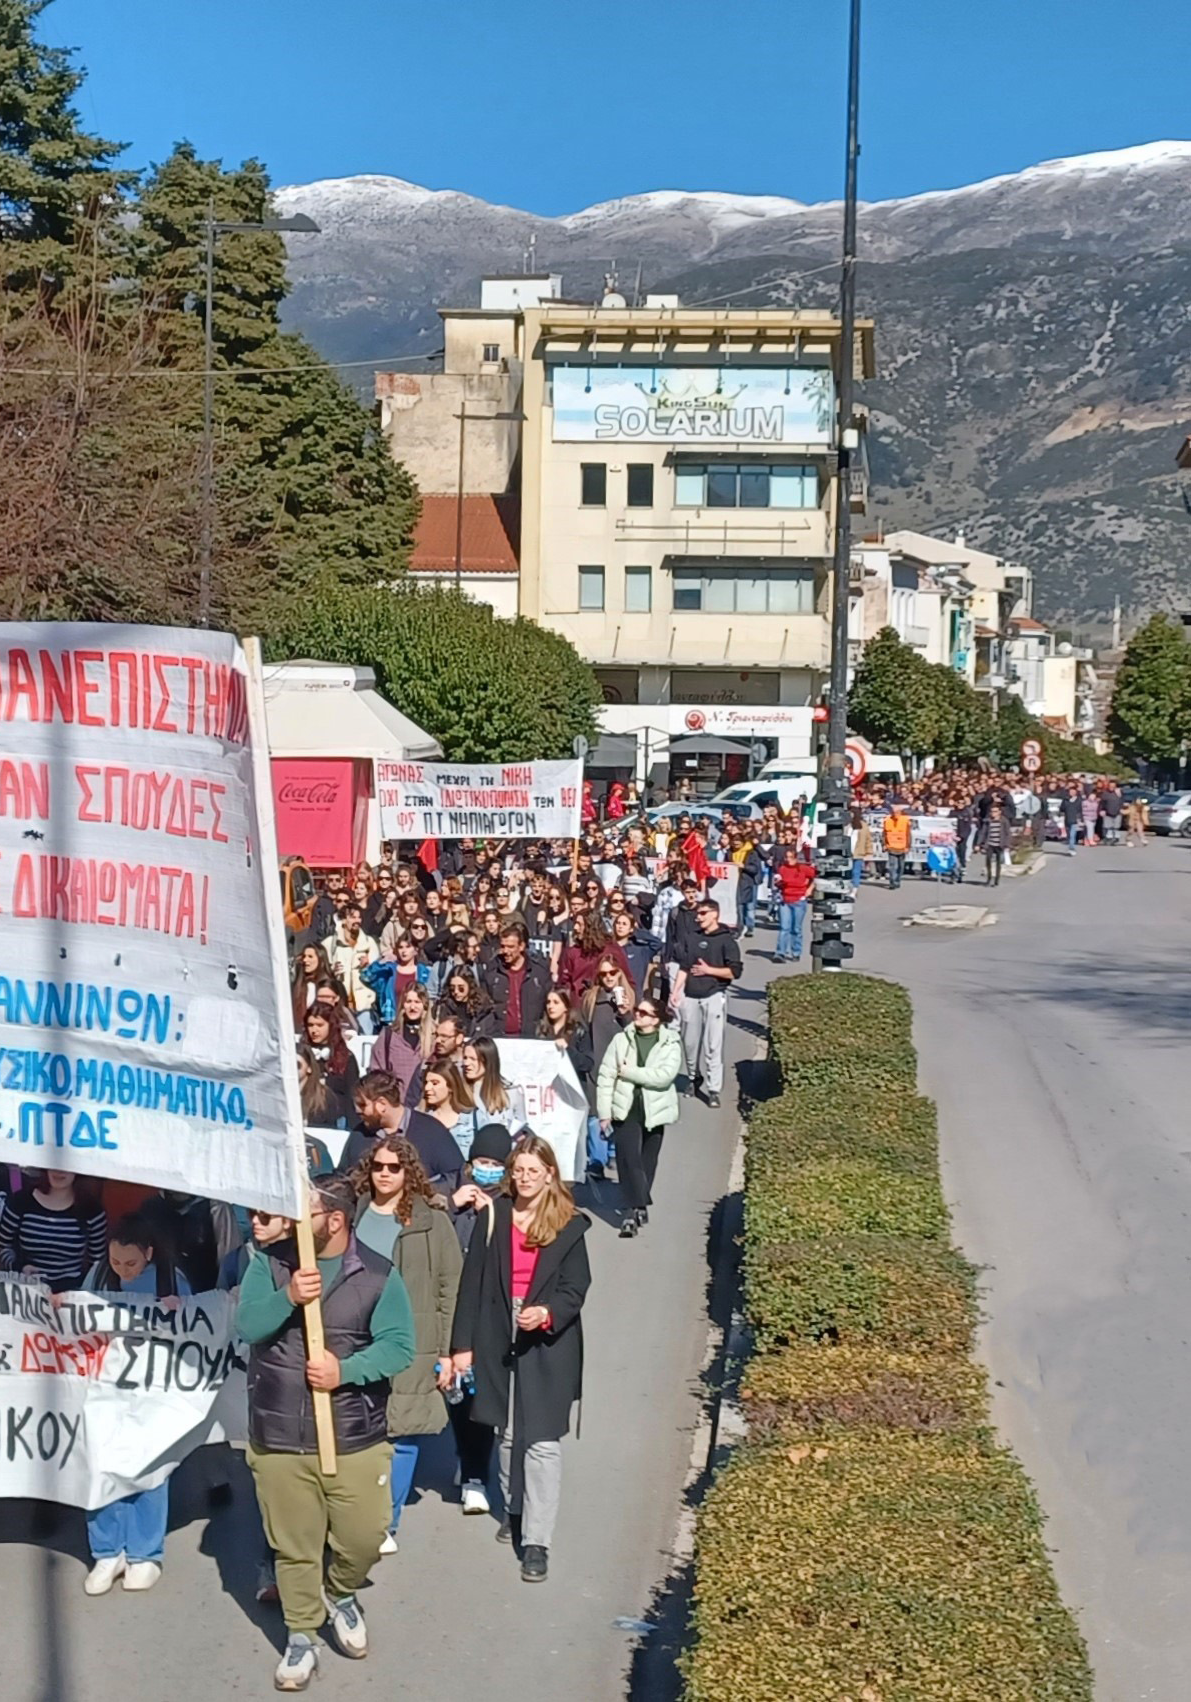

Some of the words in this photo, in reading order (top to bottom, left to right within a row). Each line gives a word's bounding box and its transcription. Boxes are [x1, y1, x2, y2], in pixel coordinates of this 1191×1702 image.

[594, 404, 784, 441] SOLARIUM
[377, 764, 424, 783] ΑΓΩΝΑΣ
[437, 774, 470, 786] ΜΕΧΡΙ
[501, 766, 533, 786] ΝΙΚΗ
[13, 853, 209, 945] ΔΙΚΑΙΩΜΑΤΑ!
